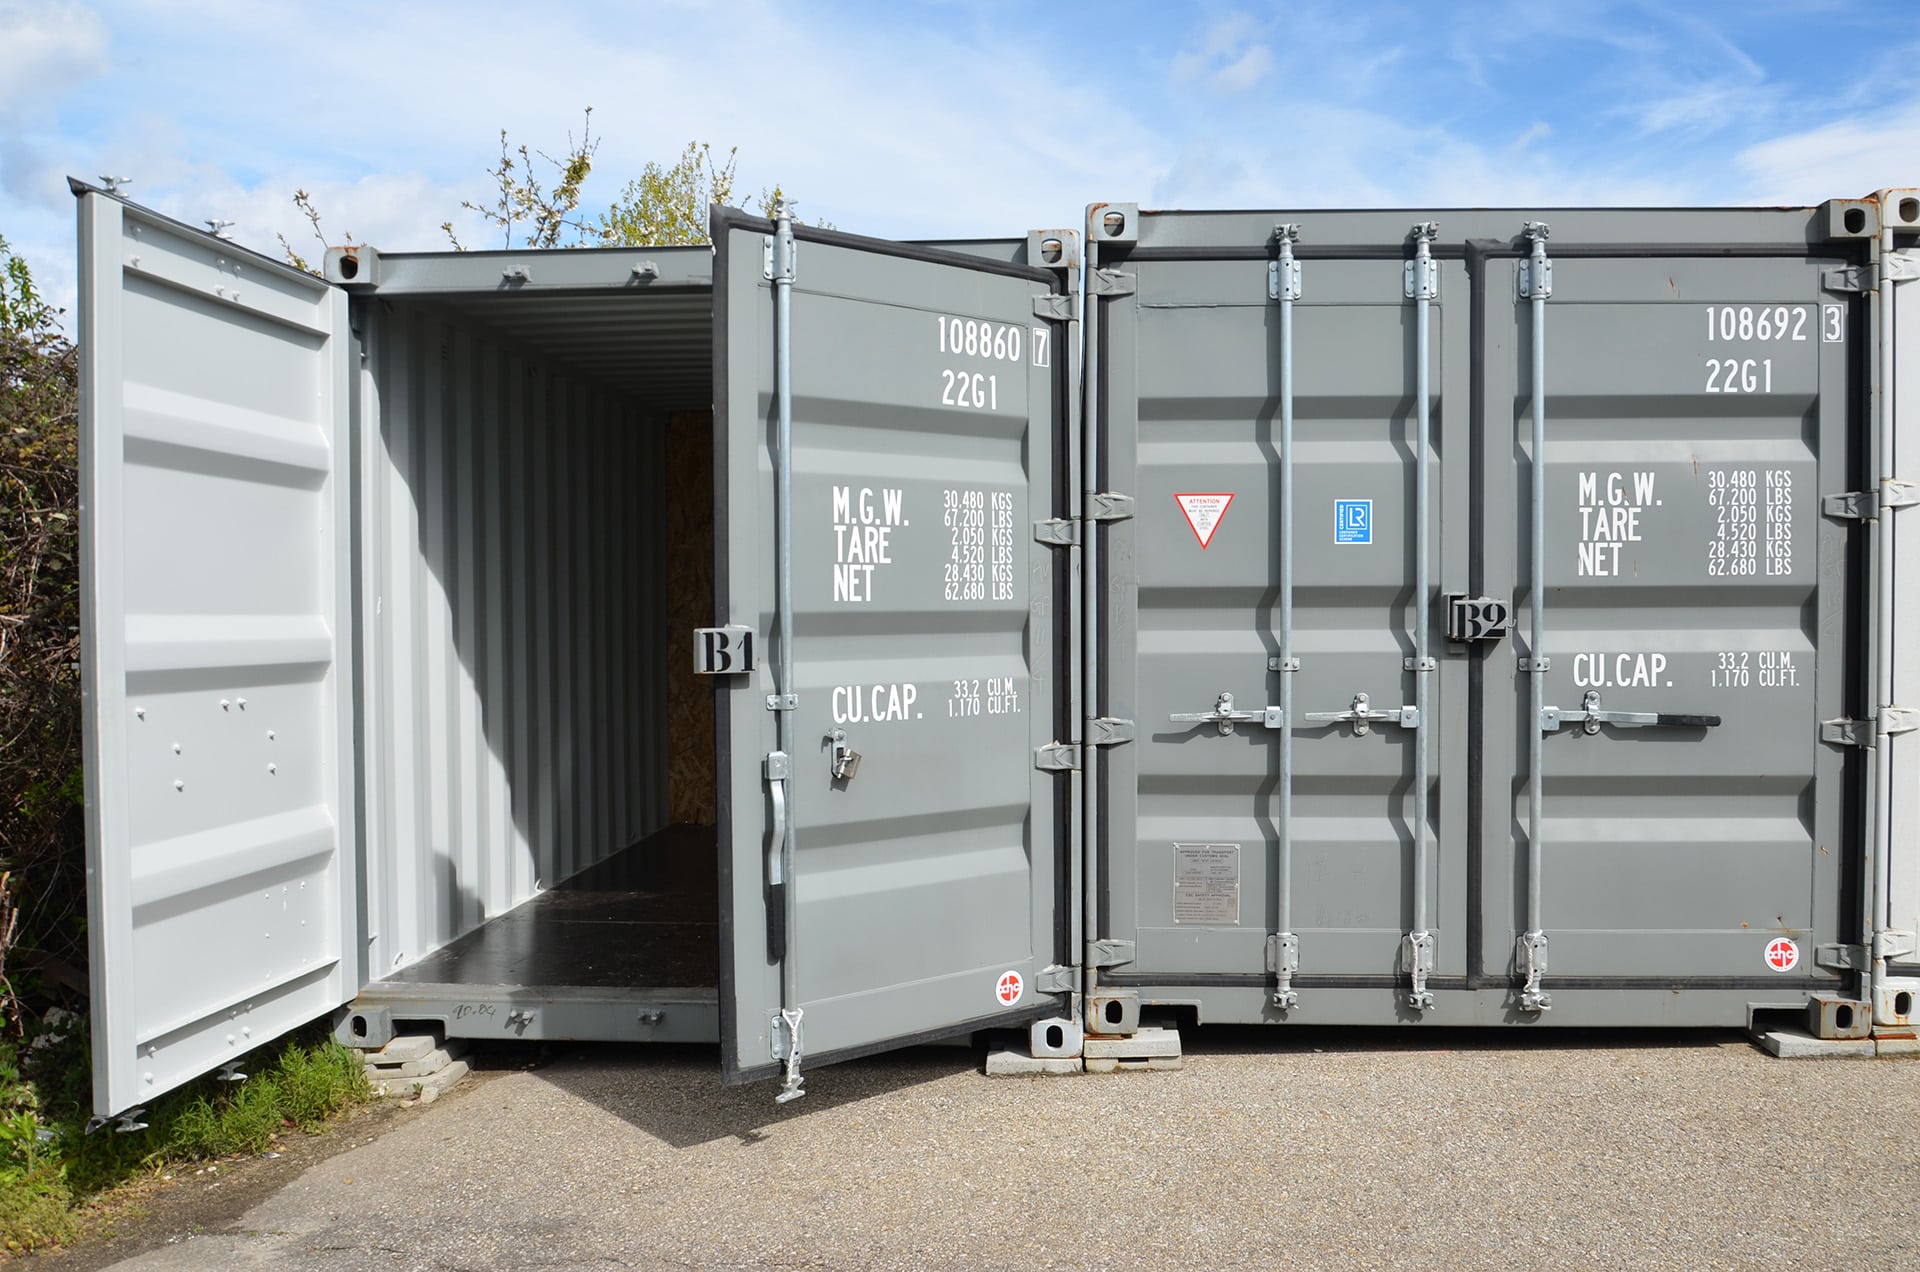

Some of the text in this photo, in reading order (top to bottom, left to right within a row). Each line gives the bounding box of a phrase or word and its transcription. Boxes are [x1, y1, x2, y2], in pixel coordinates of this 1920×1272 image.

[1706, 306, 1841, 341] 108692 3
[938, 316, 1048, 364] 108860 7
[1705, 358, 1771, 393] 22G1
[942, 369, 997, 410] 22G1
[1766, 470, 1791, 487] KGS
[1578, 472, 1662, 506] M.G.W.
[1766, 488, 1792, 505] LBS
[833, 486, 909, 526] M.G.W.
[991, 492, 1012, 510] KGS
[991, 510, 1012, 528] LBS
[1350, 508, 1365, 527] LR
[1579, 507, 1642, 541] TARE
[1766, 505, 1792, 523] KGS
[991, 528, 1012, 546] KGS
[1766, 523, 1792, 540] LBS
[833, 525, 892, 564] TARE
[1766, 541, 1792, 558] KGS
[991, 546, 1012, 564] LBS
[1578, 542, 1623, 576] NET
[991, 564, 1013, 582] KGS
[1766, 558, 1792, 575] LBS
[833, 564, 875, 602] NET
[992, 582, 1013, 601] LBS
[1455, 603, 1507, 638] B2
[702, 631, 756, 672] B1
[1718, 651, 1795, 669] 33.2 CU.M.
[1573, 653, 1673, 687] CU.CAP.
[1758, 669, 1800, 687] CU.FT.
[953, 677, 1017, 698] 33.2 CU.M.
[832, 683, 923, 724] CU.CAP.
[987, 694, 1021, 714] CU.FT.
